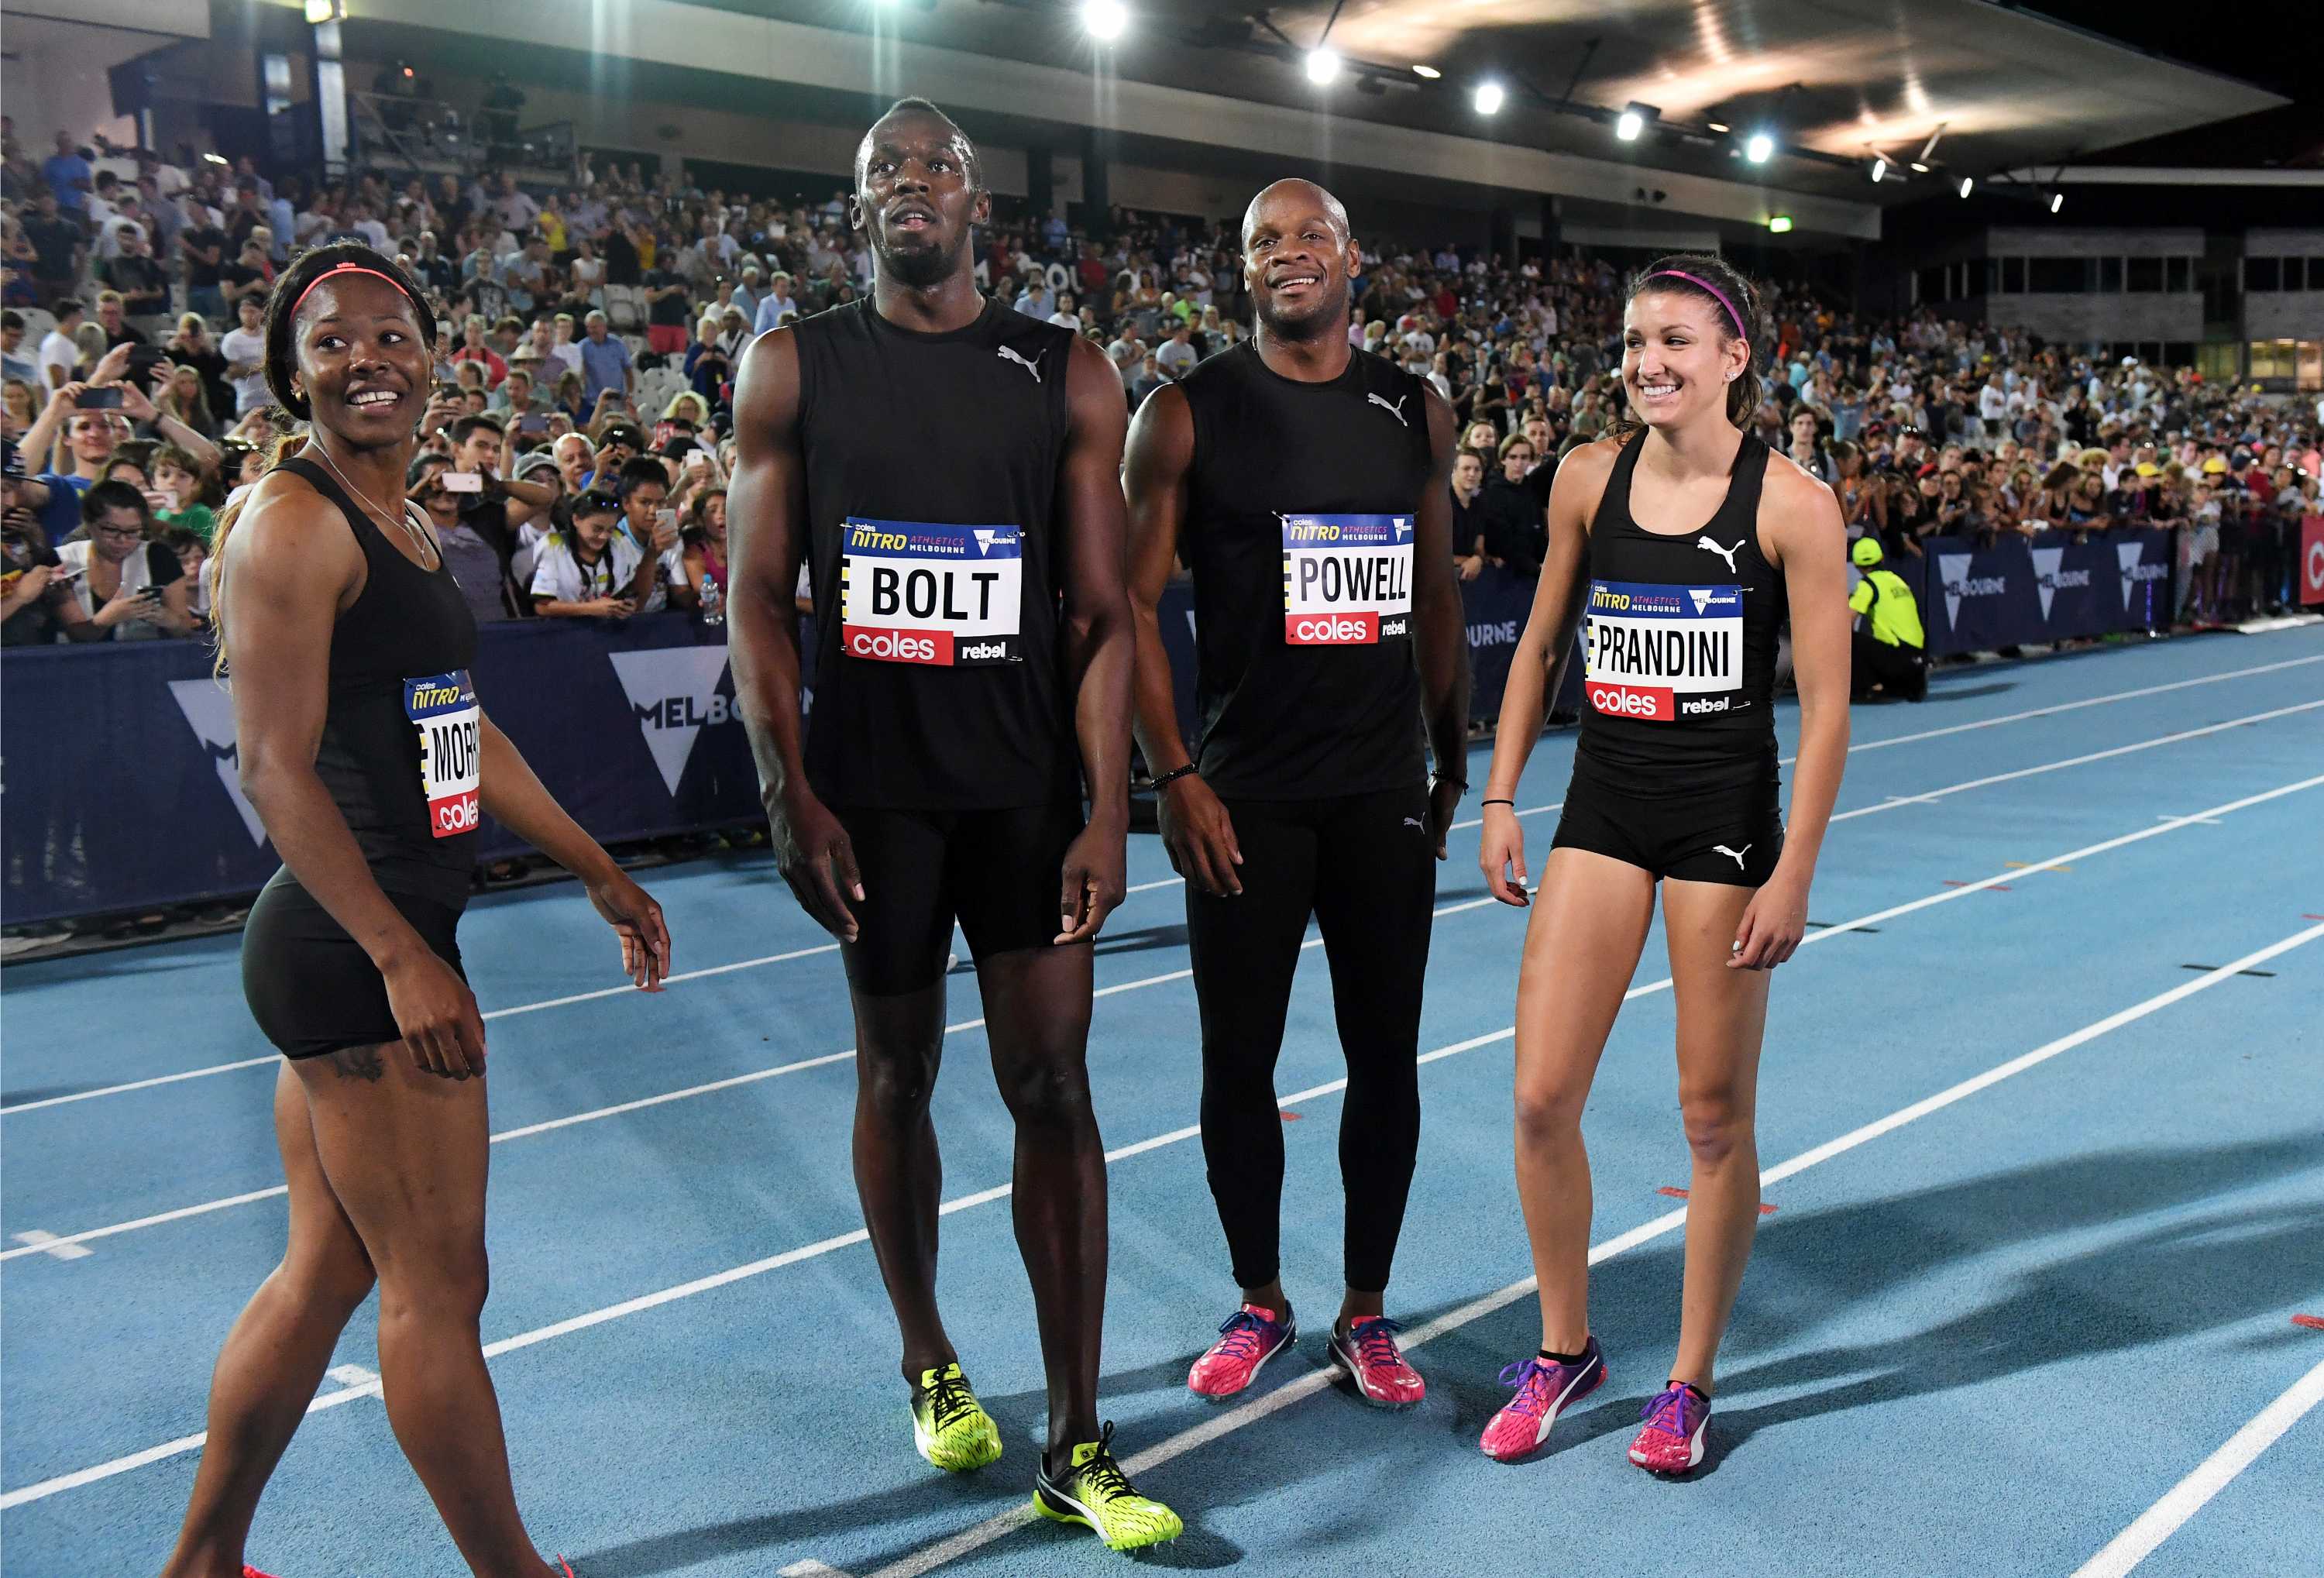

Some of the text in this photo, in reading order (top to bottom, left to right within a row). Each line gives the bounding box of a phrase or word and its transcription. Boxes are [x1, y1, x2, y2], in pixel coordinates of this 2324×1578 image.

[855, 524, 875, 532] coles
[1291, 526, 1340, 541] NITRO
[851, 531, 907, 551] NITRO
[909, 535, 965, 546] ATHLETICS
[909, 544, 965, 554] MELBOURNE
[1300, 556, 1406, 602] POWELL
[872, 567, 999, 621] BOLT
[1592, 593, 1631, 610] NITRO
[1632, 596, 1680, 605] ATHLETICS
[1631, 604, 1680, 613] MELBOURNE
[1297, 615, 1367, 641] coles
[1382, 620, 1406, 636] rebel
[853, 631, 935, 660] coles
[962, 642, 1006, 659] rebel
[1598, 624, 1728, 676] PRANDINI
[413, 686, 459, 710] NITRO
[1593, 687, 1656, 716] coles
[1683, 696, 1730, 714] rebel
